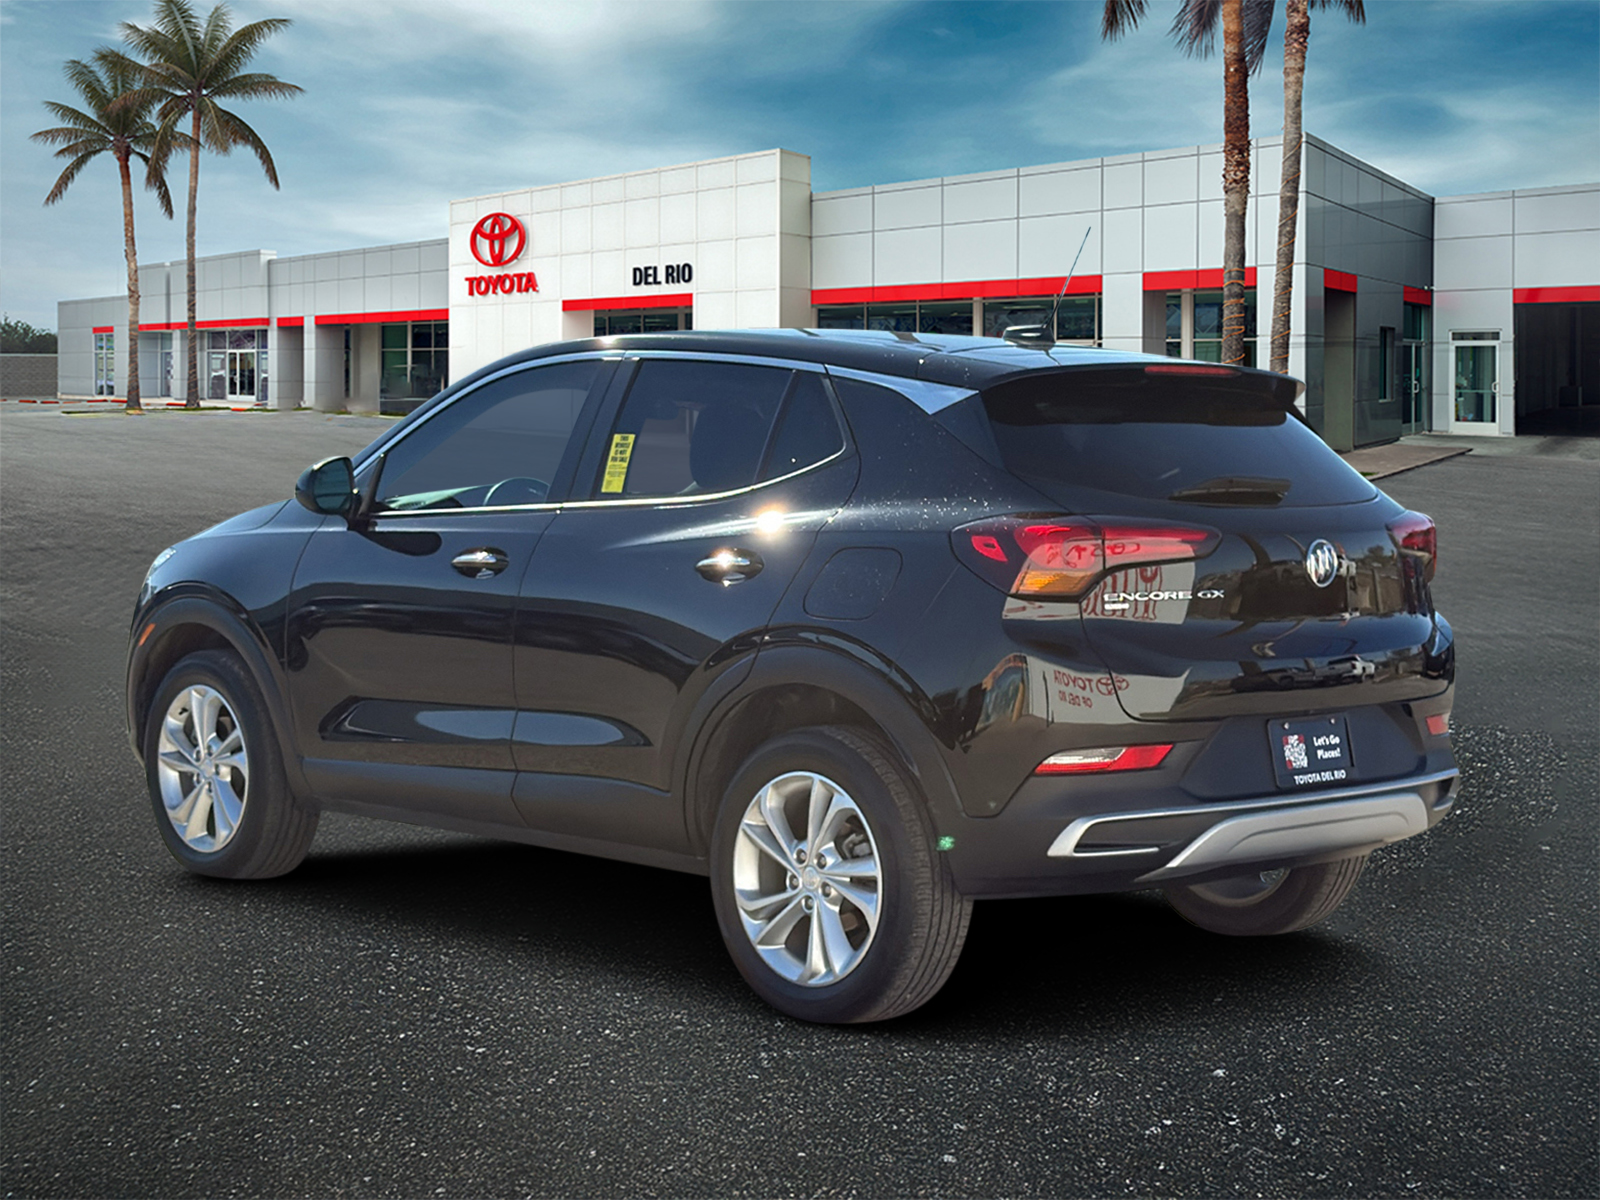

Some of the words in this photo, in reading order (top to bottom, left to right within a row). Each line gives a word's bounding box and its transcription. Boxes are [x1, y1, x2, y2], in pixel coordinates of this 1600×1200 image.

[632, 266, 661, 286] DEL
[665, 263, 693, 284] RIO
[465, 272, 539, 297] TOYOTA
[1103, 590, 1192, 601] ENCORE
[1197, 589, 1225, 599] GX
[1313, 736, 1329, 747] Let's
[1329, 734, 1340, 745] Go
[1317, 747, 1341, 759] Places!
[1294, 773, 1321, 785] TOYOTA
[1321, 771, 1334, 781] DEL
[1333, 769, 1346, 780] RIO
